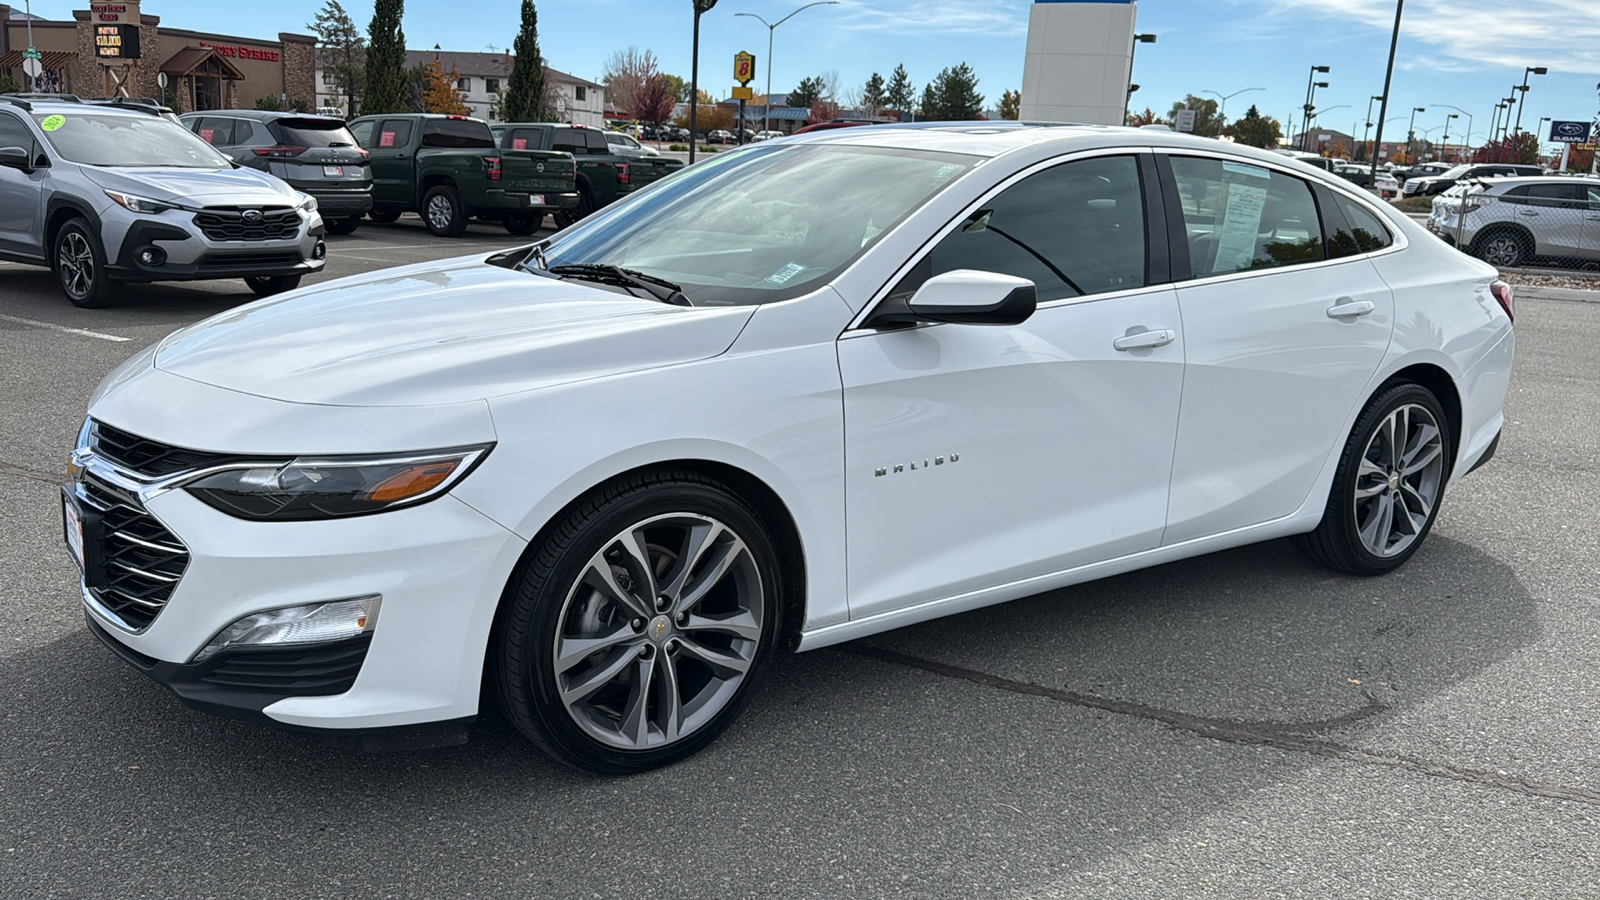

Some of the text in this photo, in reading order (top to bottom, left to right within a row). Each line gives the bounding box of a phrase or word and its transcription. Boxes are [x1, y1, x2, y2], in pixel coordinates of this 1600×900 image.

[239, 46, 279, 62] STRIKE
[738, 62, 749, 76] 8
[875, 453, 960, 477] MALIBU
